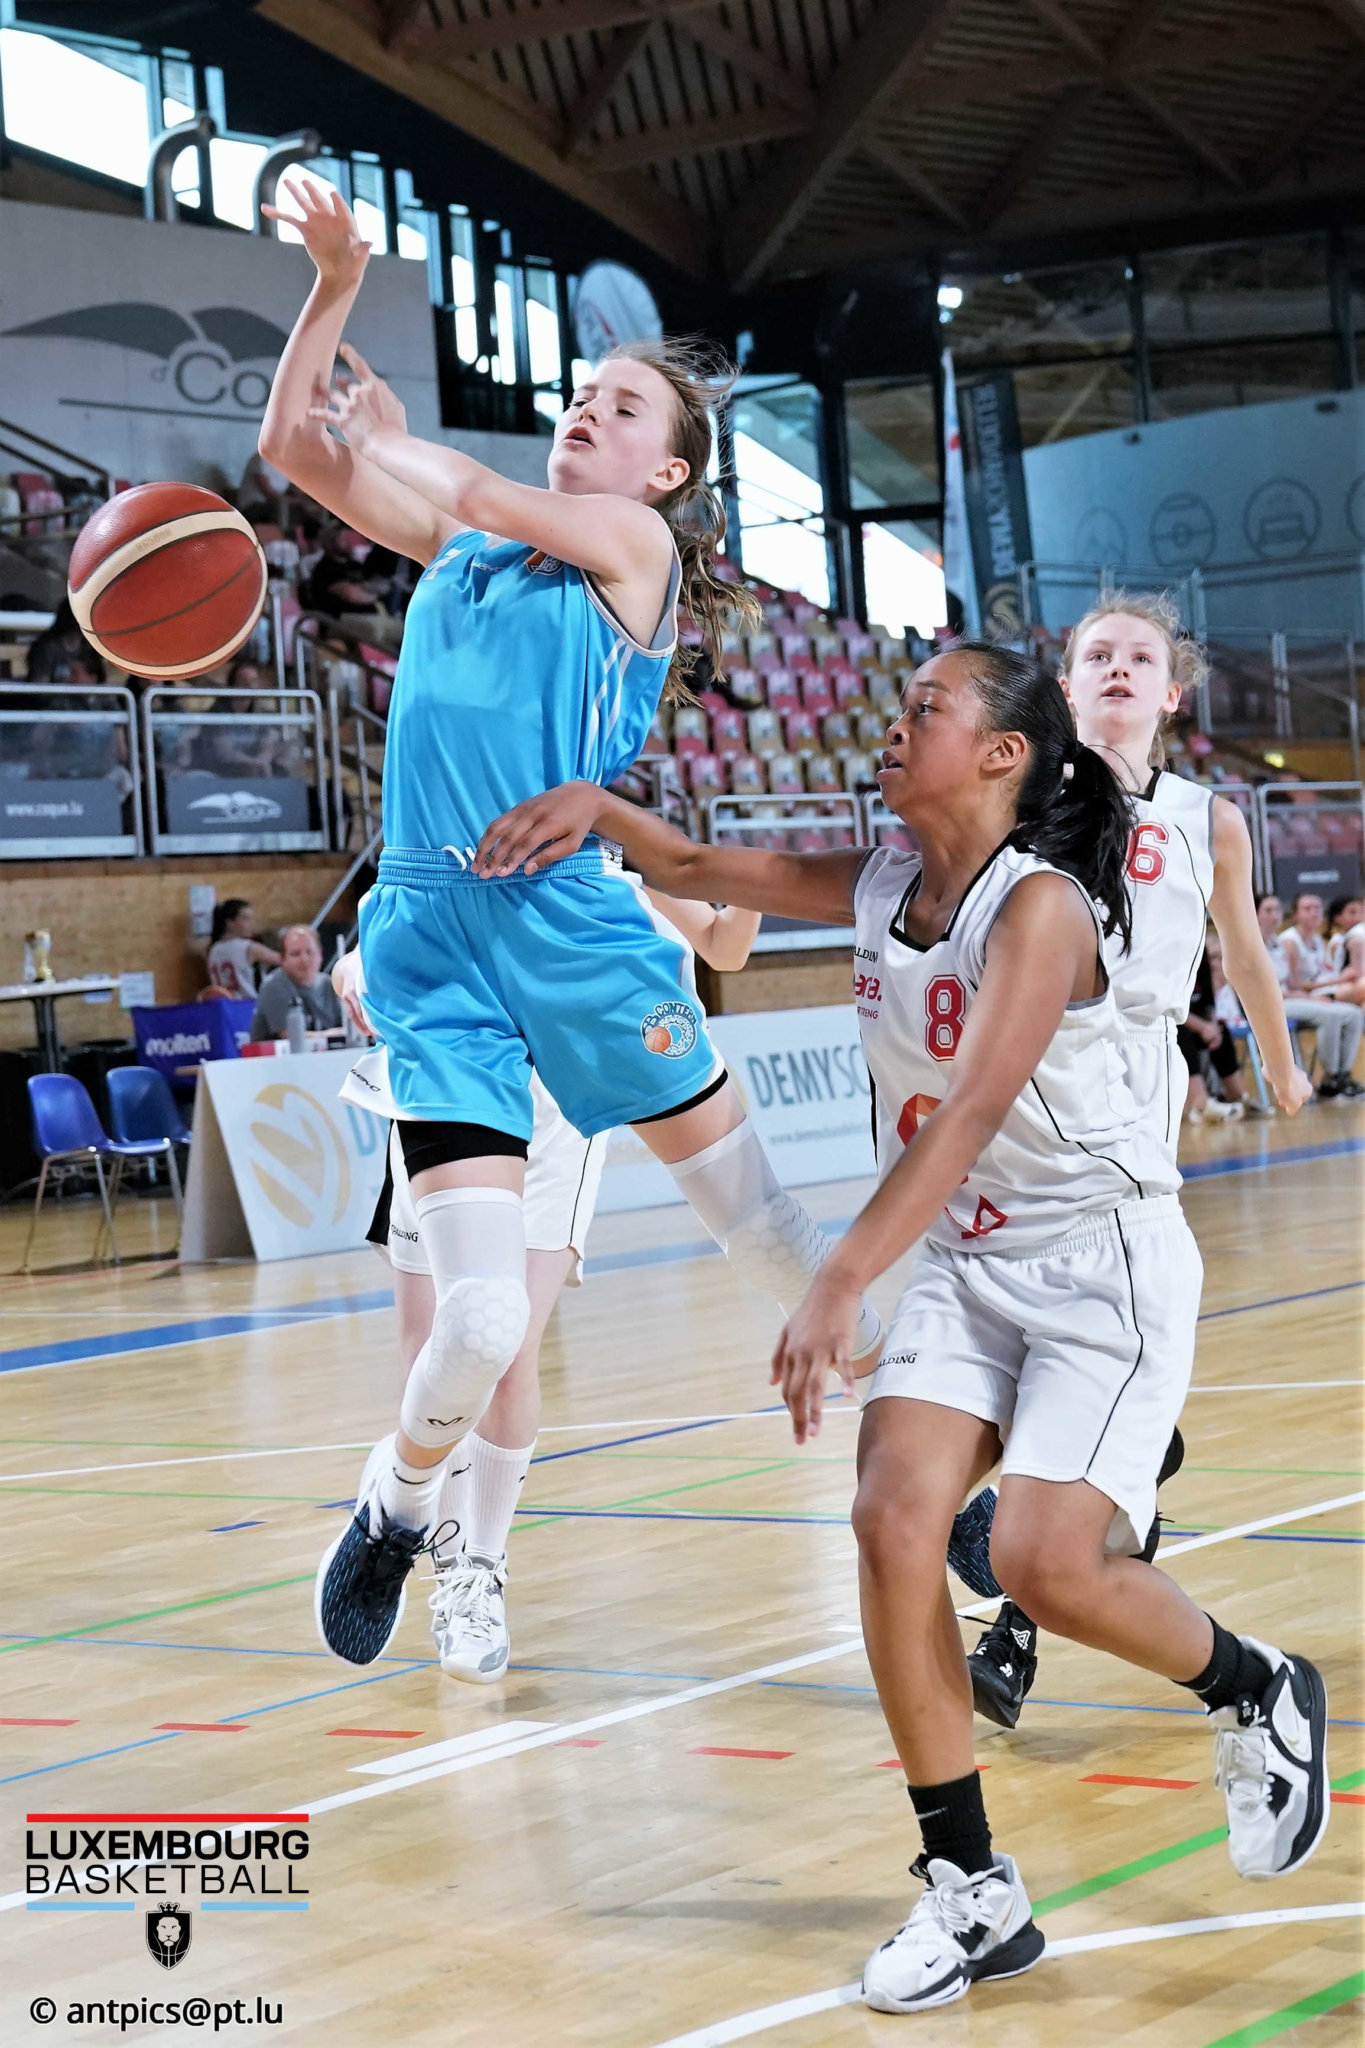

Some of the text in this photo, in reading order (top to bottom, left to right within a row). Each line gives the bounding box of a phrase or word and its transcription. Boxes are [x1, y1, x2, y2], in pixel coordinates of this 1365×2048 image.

[1121, 821, 1169, 886] 6
[145, 1032, 211, 1057] molten
[924, 974, 966, 1062] 8
[746, 1043, 871, 1109] DEMYSC
